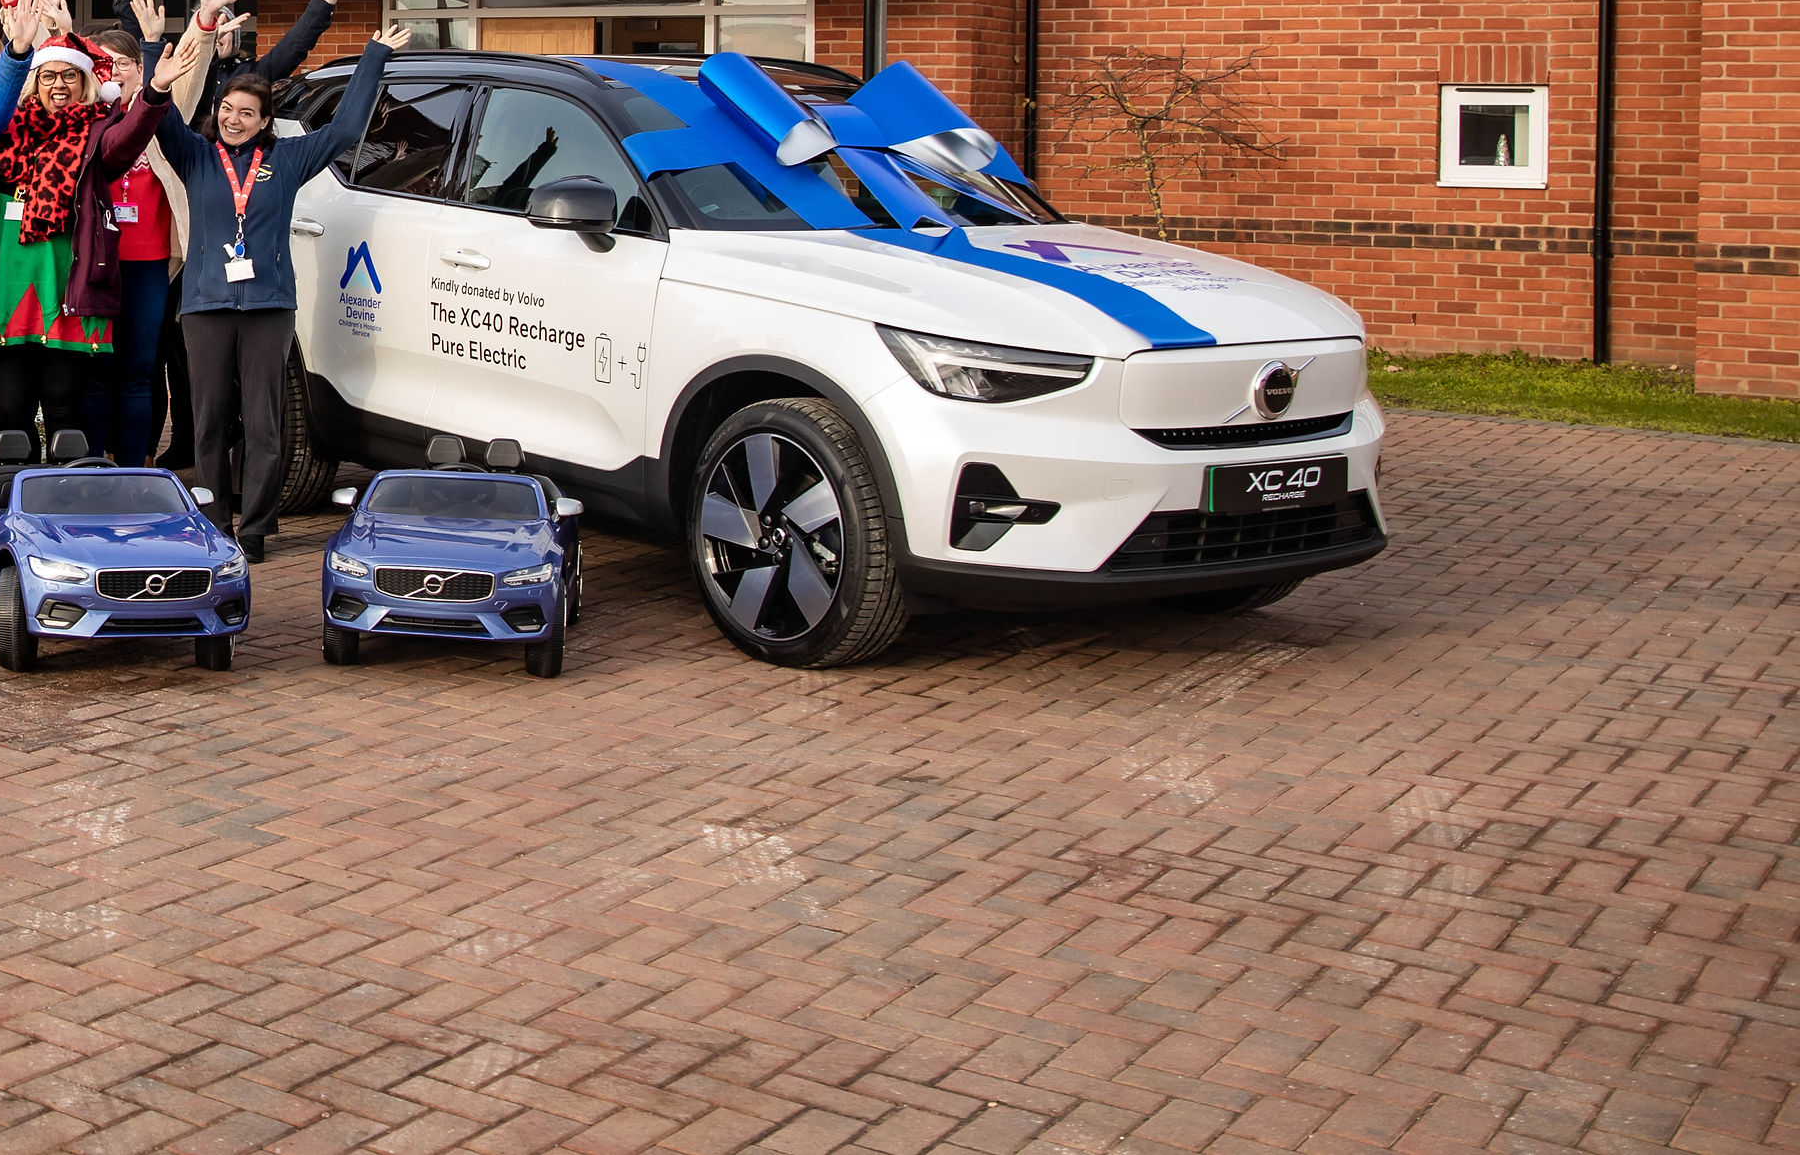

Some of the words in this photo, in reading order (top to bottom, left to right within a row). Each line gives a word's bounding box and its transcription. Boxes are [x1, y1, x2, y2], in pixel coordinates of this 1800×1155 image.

[339, 292, 382, 309] Alexander
[431, 276, 460, 296] Kindly
[461, 282, 501, 300] donated
[503, 288, 515, 306] by
[517, 291, 545, 308] Volvo
[346, 306, 376, 322] Devine
[430, 301, 456, 324] The
[460, 306, 503, 333] XC40
[509, 316, 585, 352] Recharge
[431, 332, 465, 357] Pure
[469, 340, 527, 369] Electric
[1265, 387, 1293, 396] VOLVO
[1261, 490, 1307, 502] RECHARGE
